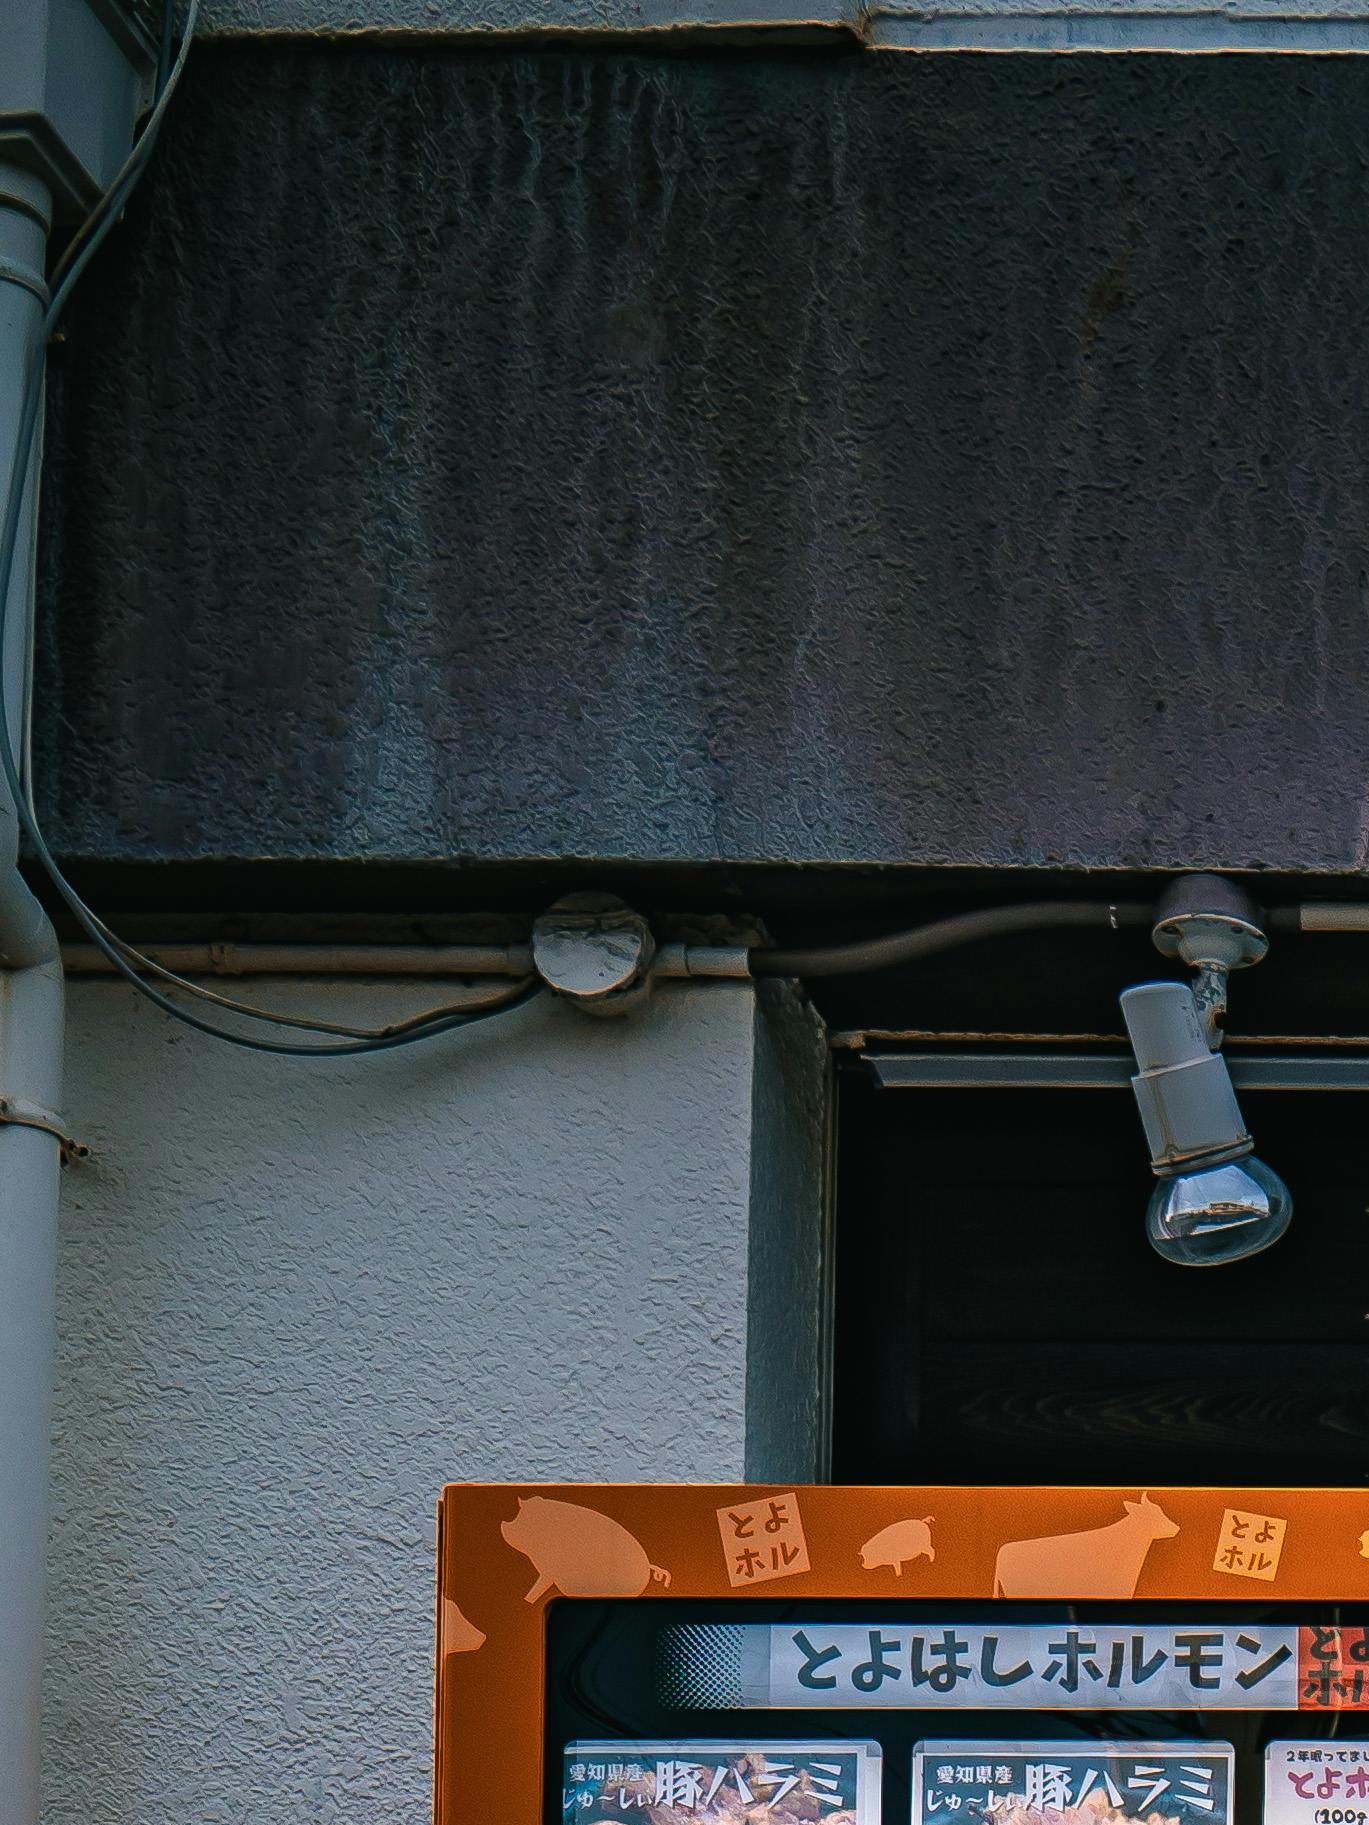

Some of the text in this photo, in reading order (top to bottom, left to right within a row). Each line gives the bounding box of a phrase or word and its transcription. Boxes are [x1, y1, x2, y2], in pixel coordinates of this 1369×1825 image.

[728, 1503, 790, 1540] とよ
[734, 1542, 799, 1580] ホル
[792, 1630, 1292, 1693] とよはしホルモン
[654, 1760, 845, 1810] 豚ハラミ
[1024, 1764, 1214, 1813] 豚ハラミ
